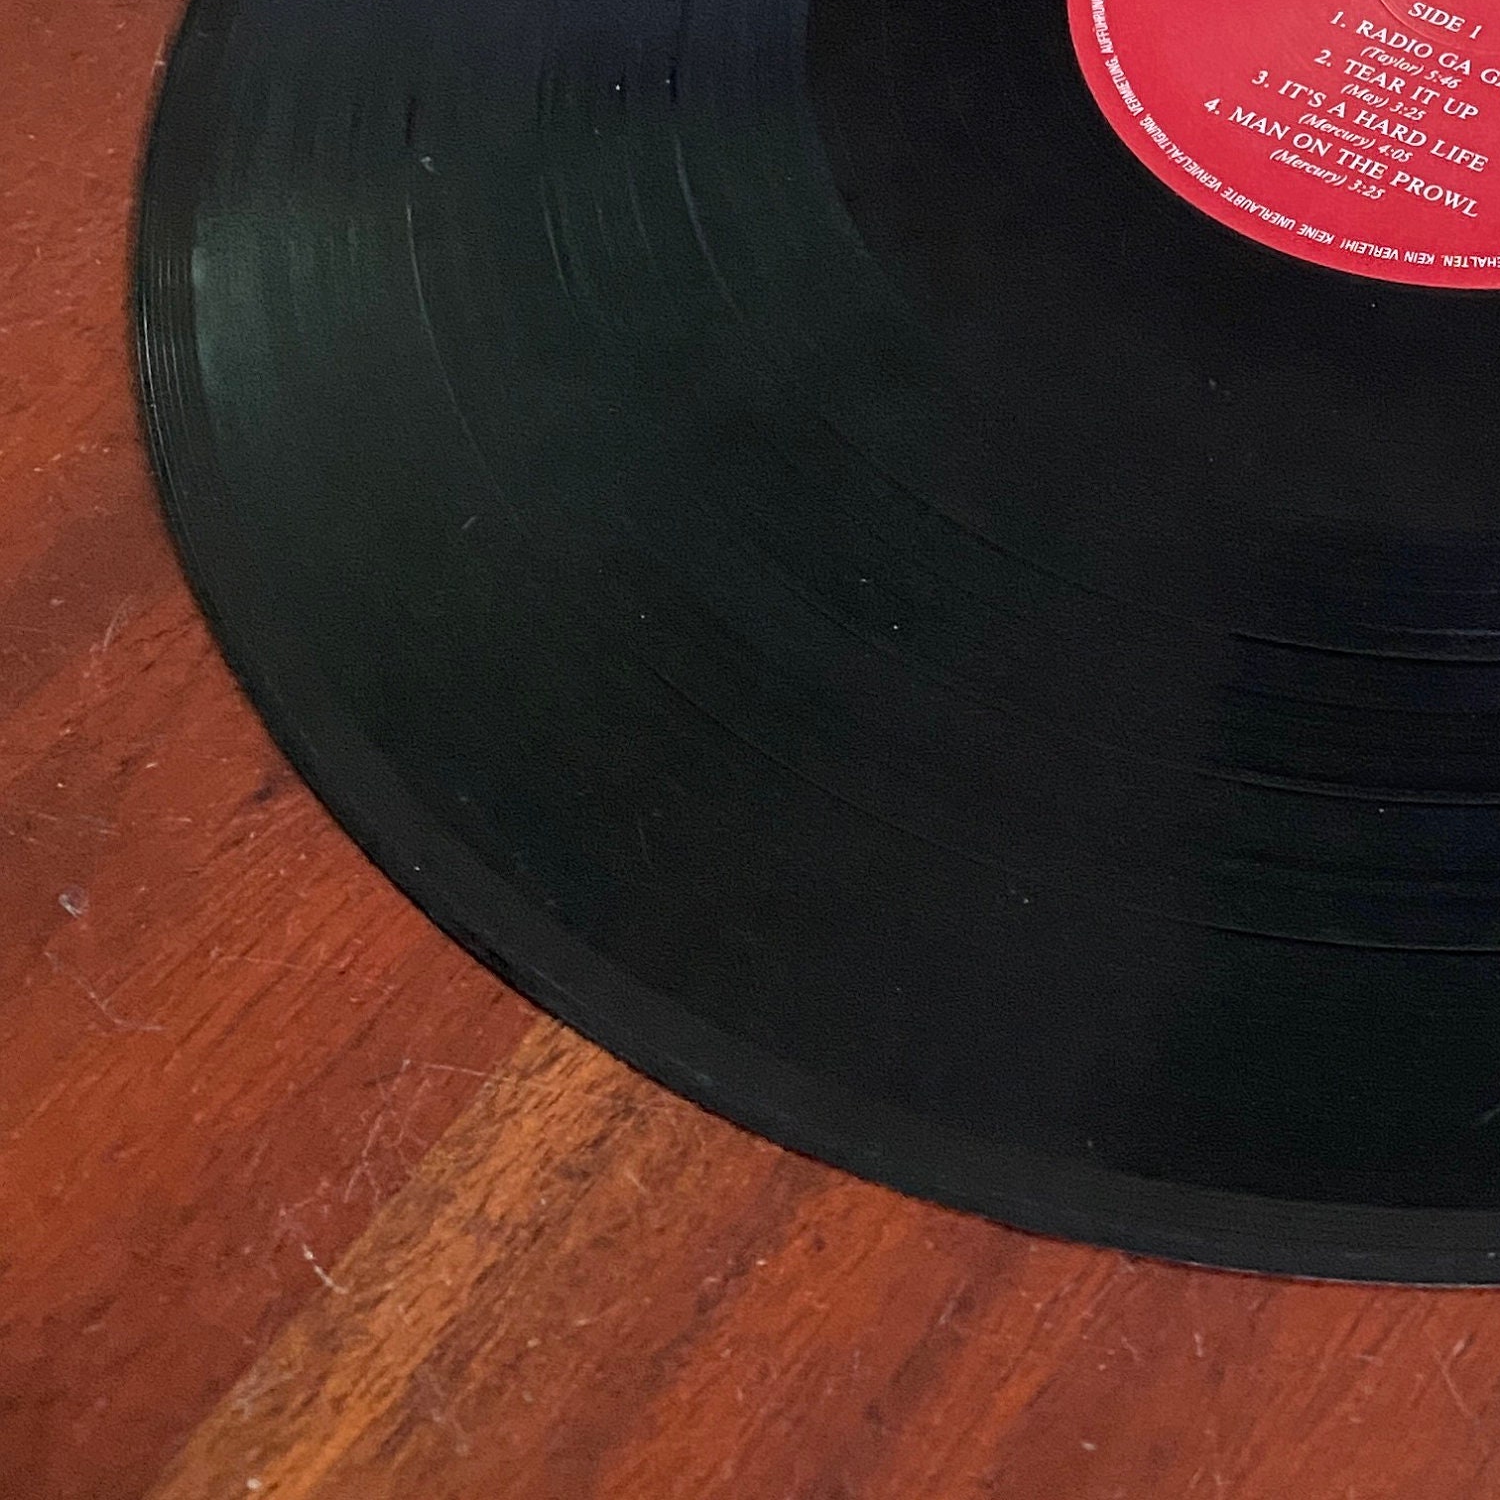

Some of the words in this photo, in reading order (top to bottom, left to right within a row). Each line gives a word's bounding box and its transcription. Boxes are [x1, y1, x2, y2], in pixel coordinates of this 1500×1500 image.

[1331, 11, 1346, 27] 1.
[1356, 20, 1433, 58] RADIO
[1438, 53, 1470, 75] GA
[1408, 2, 1465, 32] SIDE
[1469, 25, 1482, 39] 1
[1314, 49, 1331, 67] 2.
[1344, 59, 1405, 94] TEAR
[1410, 86, 1440, 104] IT
[1443, 97, 1478, 119] UP
[1360, 46, 1424, 76] (Taylor)
[1424, 70, 1462, 88] 5:46
[1252, 70, 1269, 88] 3.
[1278, 80, 1327, 107] IT'S
[1327, 102, 1345, 118] A
[1353, 110, 1427, 146] HARD
[1430, 139, 1488, 172] LIFE
[1341, 84, 1389, 108] (May)
[1389, 102, 1426, 120] 3:25
[1204, 98, 1220, 115] 4.
[1228, 106, 1290, 140] MAN
[1293, 133, 1333, 156] ON
[1336, 148, 1388, 179] THE
[1390, 171, 1477, 217] PROWL
[1298, 113, 1376, 149] (Mercury)
[1378, 145, 1413, 162] 4:05
[1270, 149, 1347, 186] (Mercury)
[1348, 179, 1386, 199] 3:25
[1220, 187, 1296, 230] UNERLAUBTE
[1297, 224, 1335, 244] KEINE
[1404, 251, 1435, 264] KEIN
